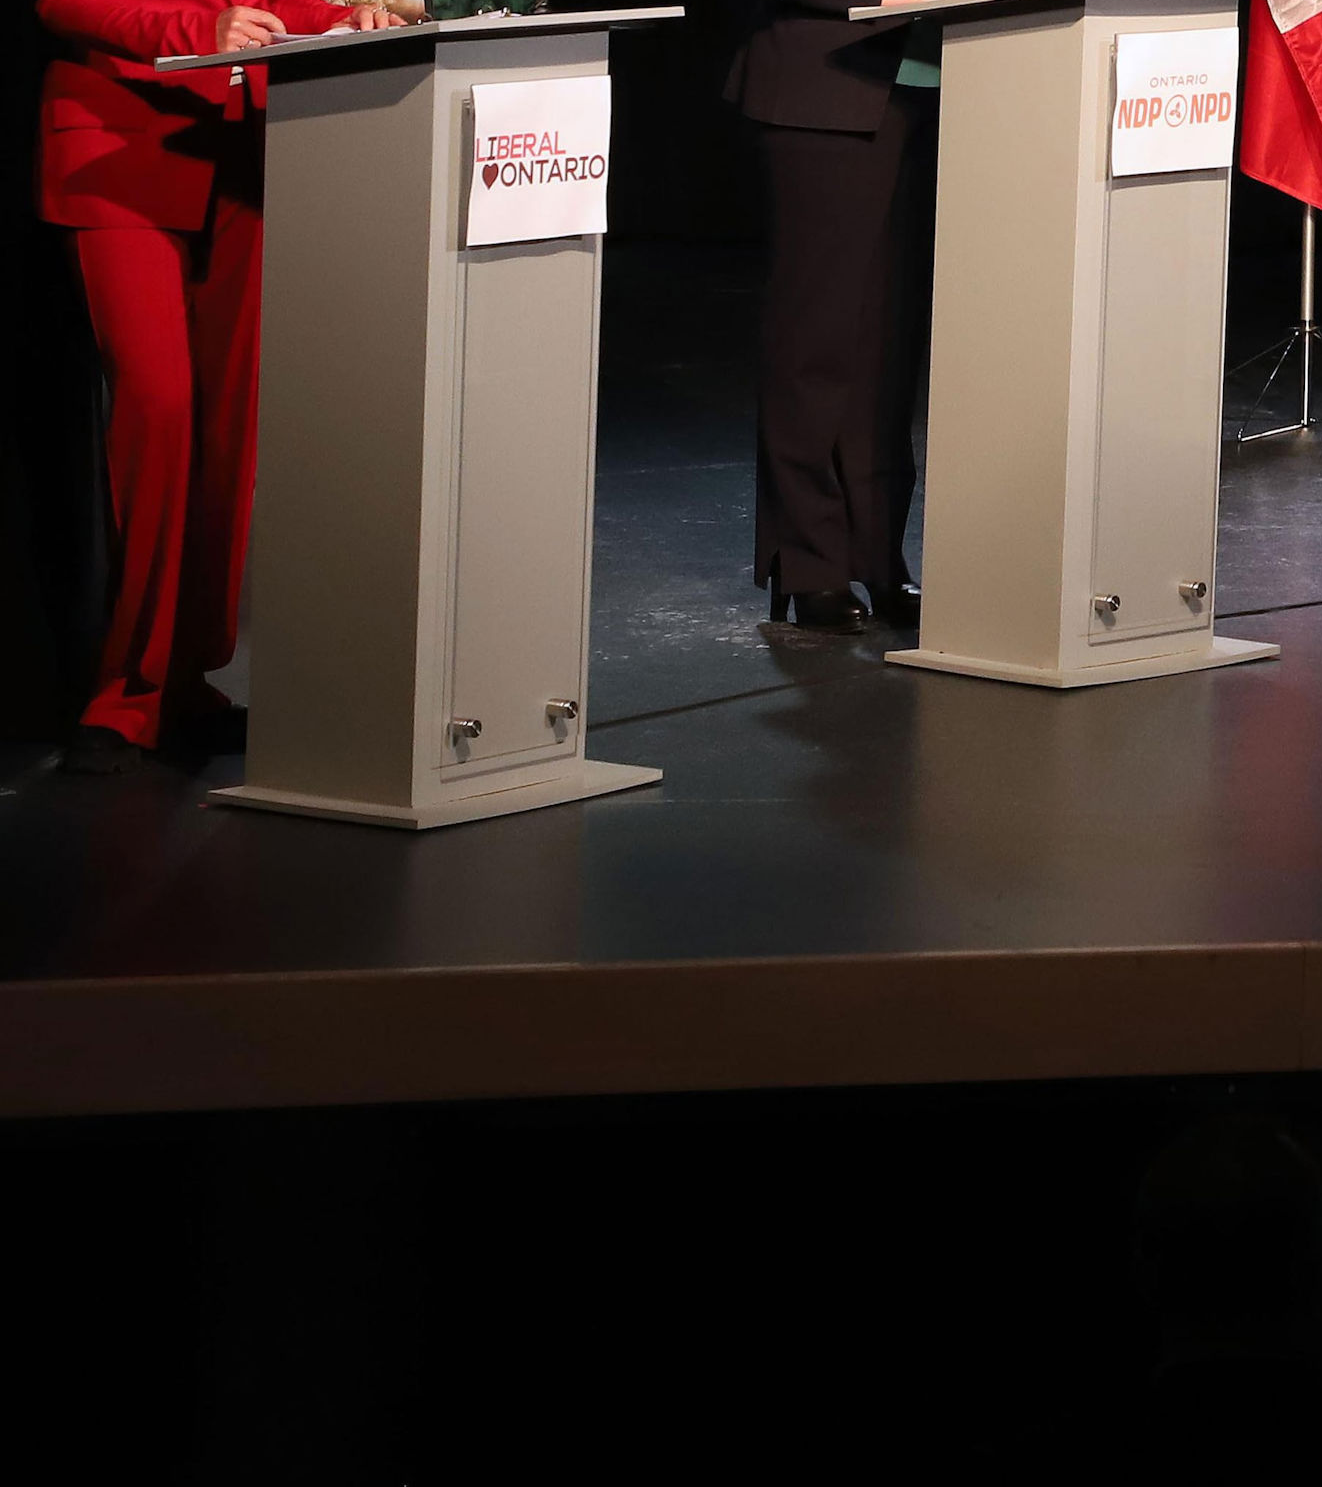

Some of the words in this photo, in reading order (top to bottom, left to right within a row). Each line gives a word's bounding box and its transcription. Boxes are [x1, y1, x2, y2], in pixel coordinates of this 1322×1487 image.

[1149, 73, 1208, 89] ONTARIO
[1117, 96, 1163, 130] NDP
[1189, 91, 1232, 125] NPD
[475, 131, 567, 163] LIBERAL
[500, 154, 606, 188] ONTARIO
